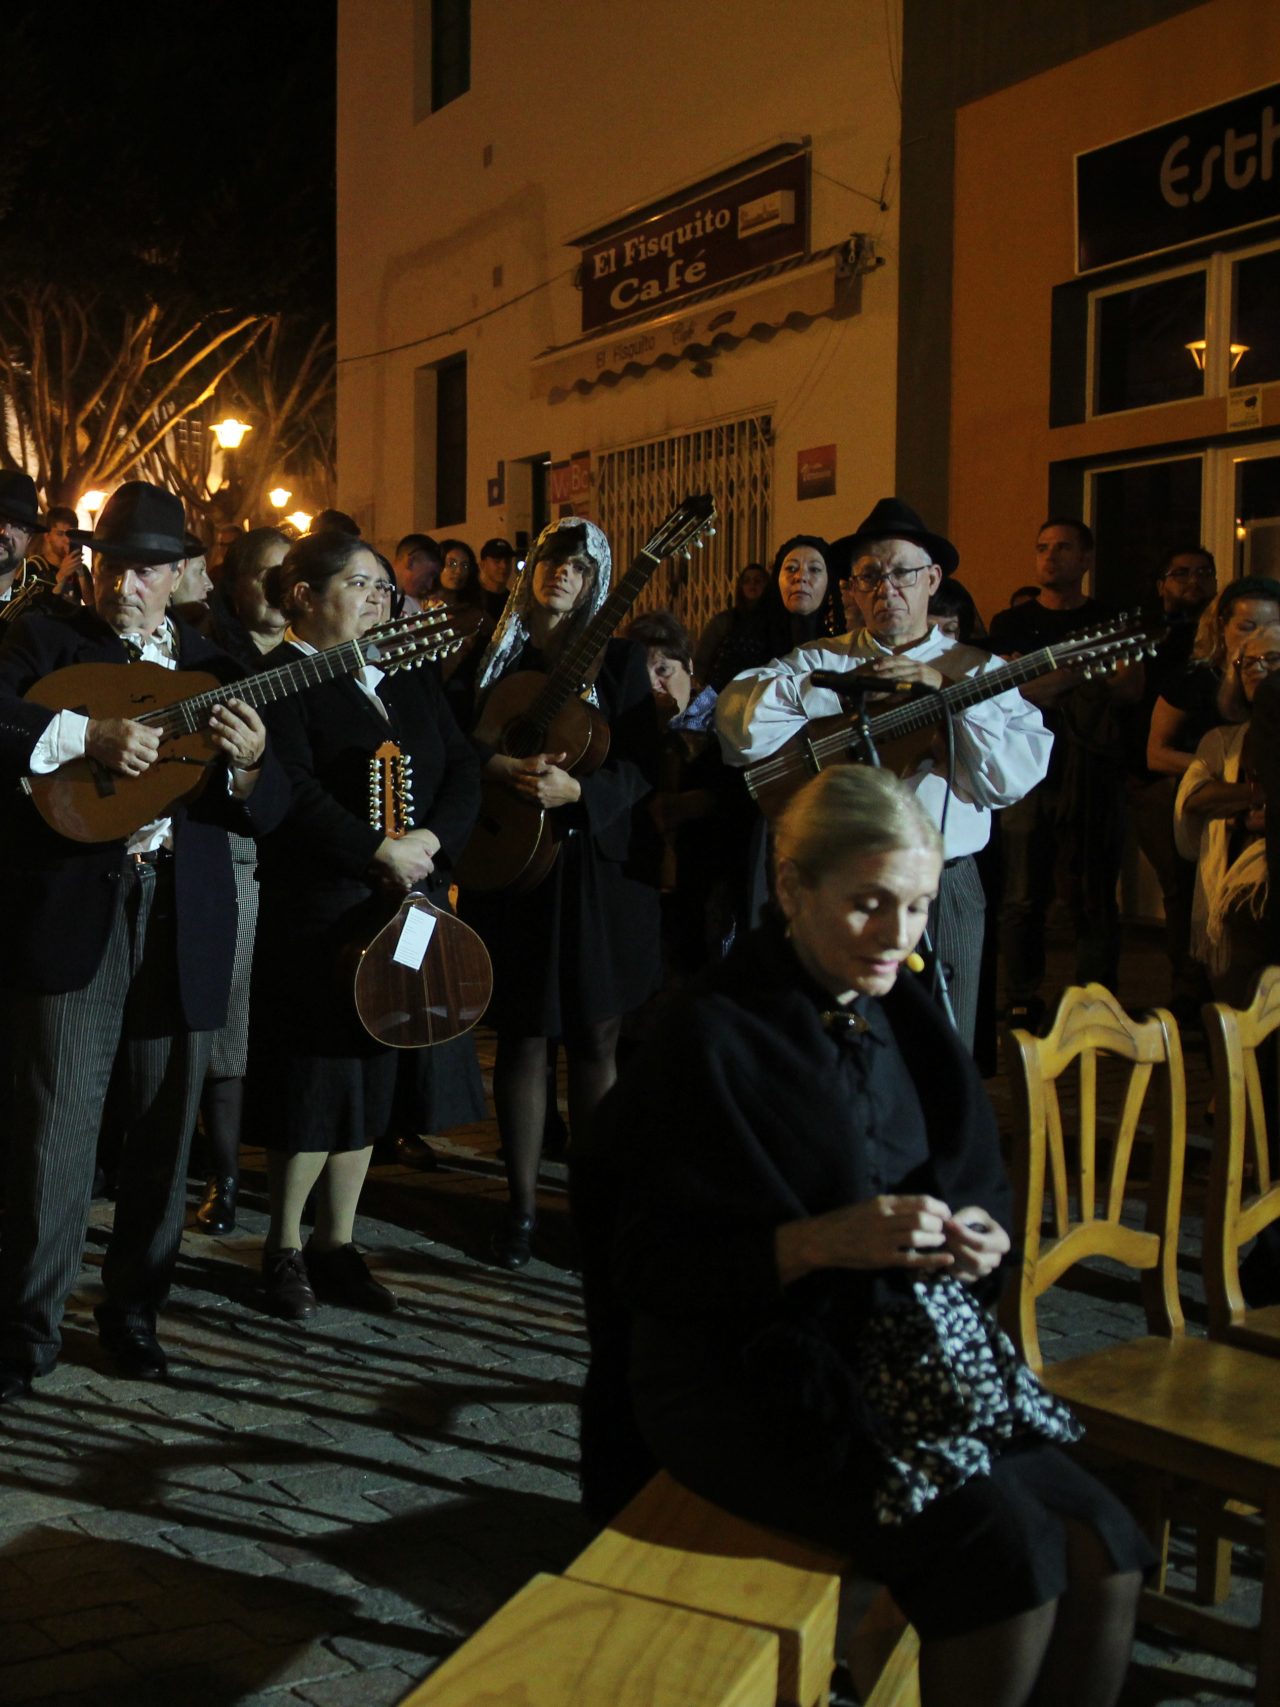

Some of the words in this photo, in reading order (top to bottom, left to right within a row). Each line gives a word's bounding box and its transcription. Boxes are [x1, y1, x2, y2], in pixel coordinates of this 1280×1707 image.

[593, 248, 617, 280] El
[624, 208, 731, 268] Fisquito
[610, 249, 708, 310] Café
